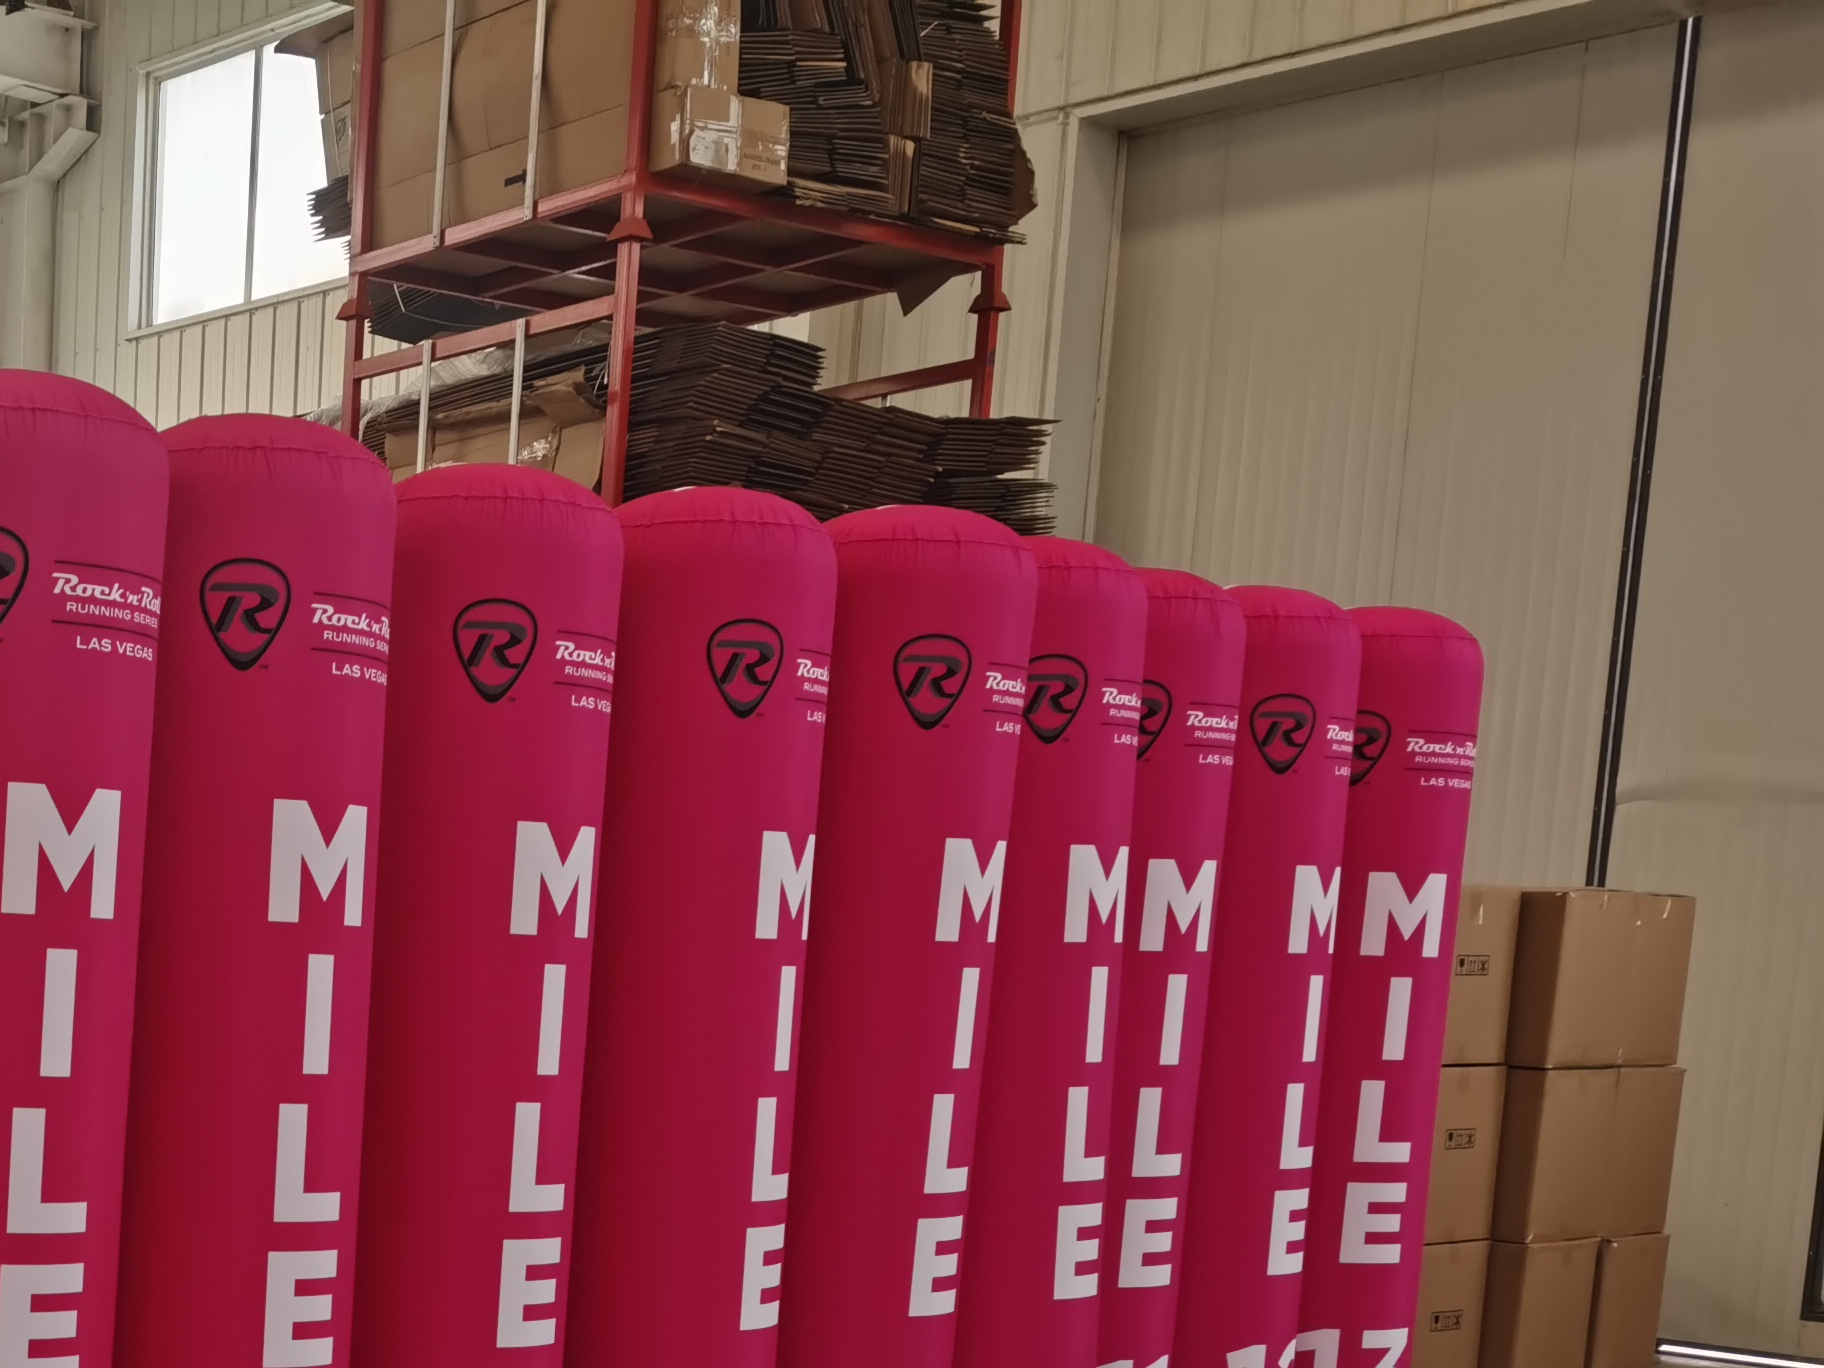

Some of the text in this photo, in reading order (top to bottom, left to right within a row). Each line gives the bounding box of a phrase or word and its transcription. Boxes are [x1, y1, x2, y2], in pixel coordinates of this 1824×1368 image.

[66, 601, 131, 620] RUNNING
[76, 635, 153, 661] LAS VEGAS
[323, 631, 375, 648] RUNNING
[332, 662, 361, 678] LAS
[572, 695, 594, 709] LAS
[996, 720, 1014, 733] LAS
[1114, 733, 1132, 745] LAS
[1199, 754, 1220, 765] LAS
[1420, 777, 1445, 788] LAS
[1118, 859, 1217, 1287] MILE
[1340, 872, 1447, 1263] MILE
[263, 800, 367, 1368] MILE
[497, 822, 596, 1348] MILE
